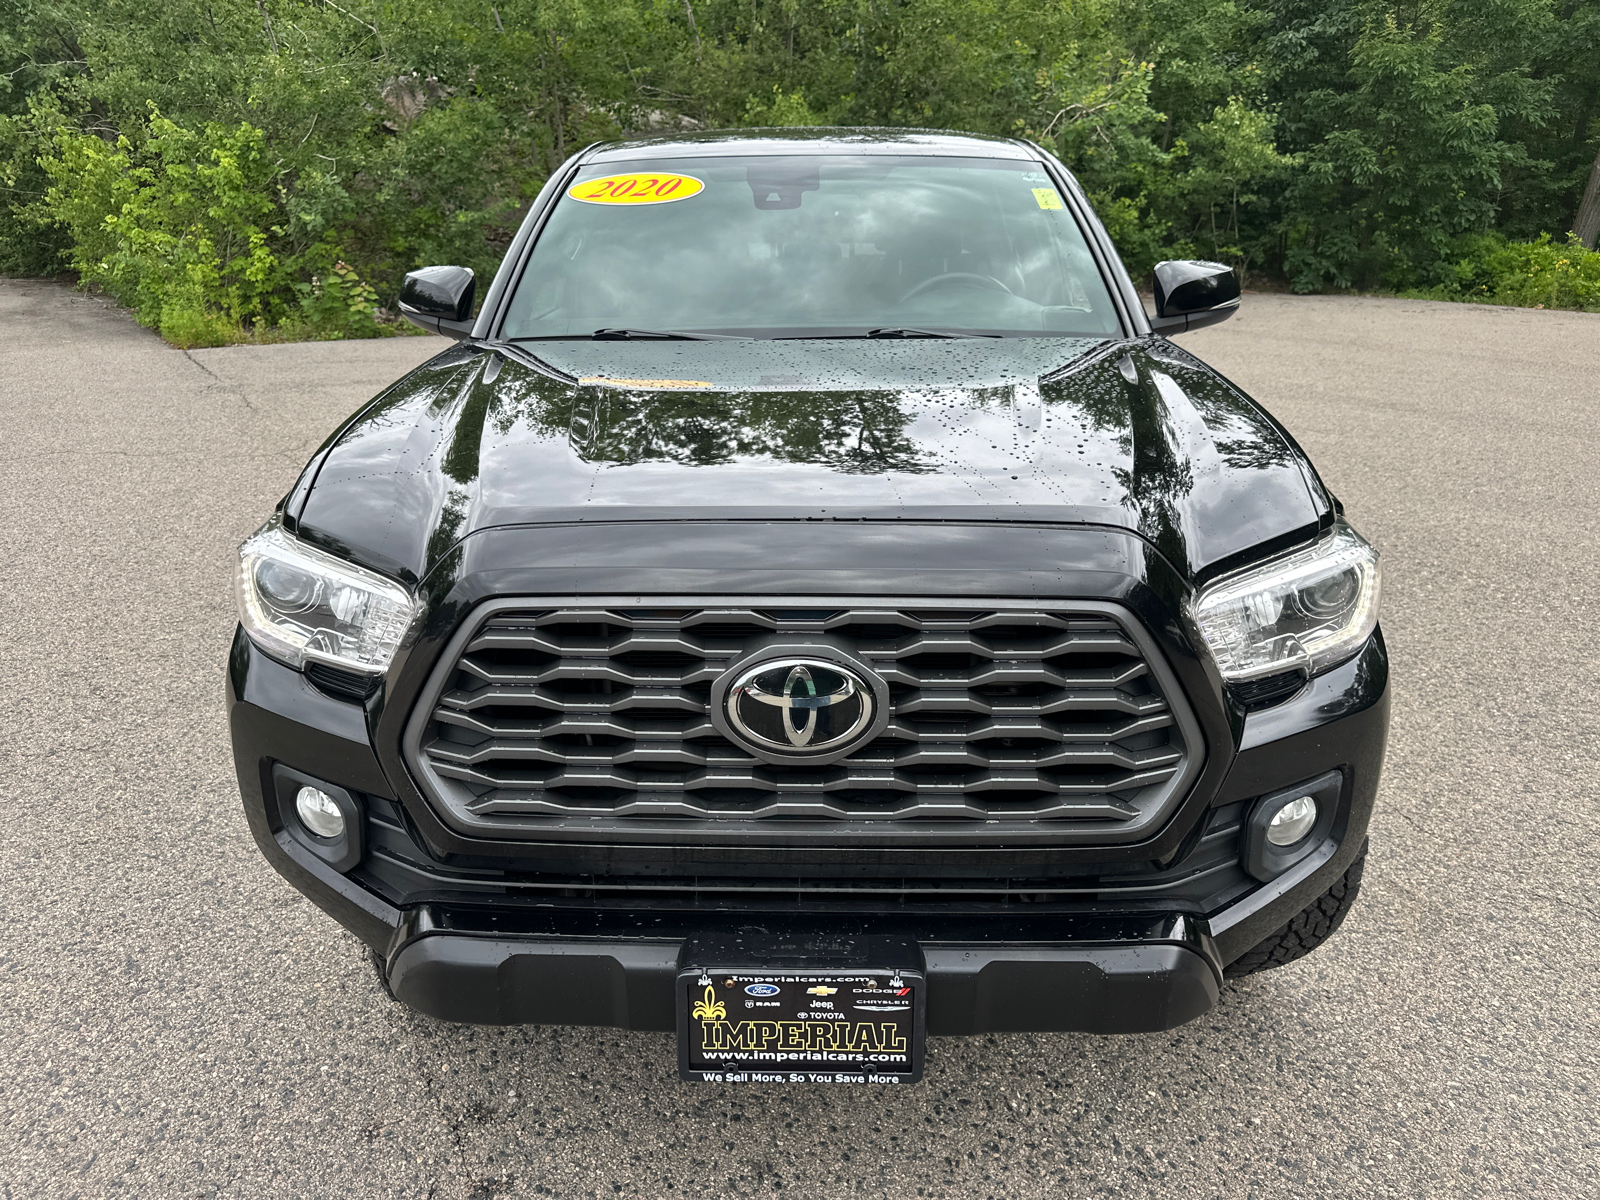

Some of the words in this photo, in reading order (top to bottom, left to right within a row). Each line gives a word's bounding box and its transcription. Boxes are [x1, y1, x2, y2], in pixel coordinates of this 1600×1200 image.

[585, 178, 682, 198] 2020
[752, 986, 772, 994] Ford
[809, 1000, 834, 1010] Jeep
[809, 1012, 846, 1020] TOYOTA
[701, 1020, 907, 1053] IMPERIAL
[702, 1050, 907, 1062] www.imperialcars.com
[702, 1073, 723, 1082] We
[725, 1073, 748, 1083] Sell
[752, 1073, 786, 1083] More,
[789, 1073, 805, 1083] So
[808, 1073, 832, 1083] You
[835, 1073, 865, 1083] Save
[868, 1074, 899, 1084] More
